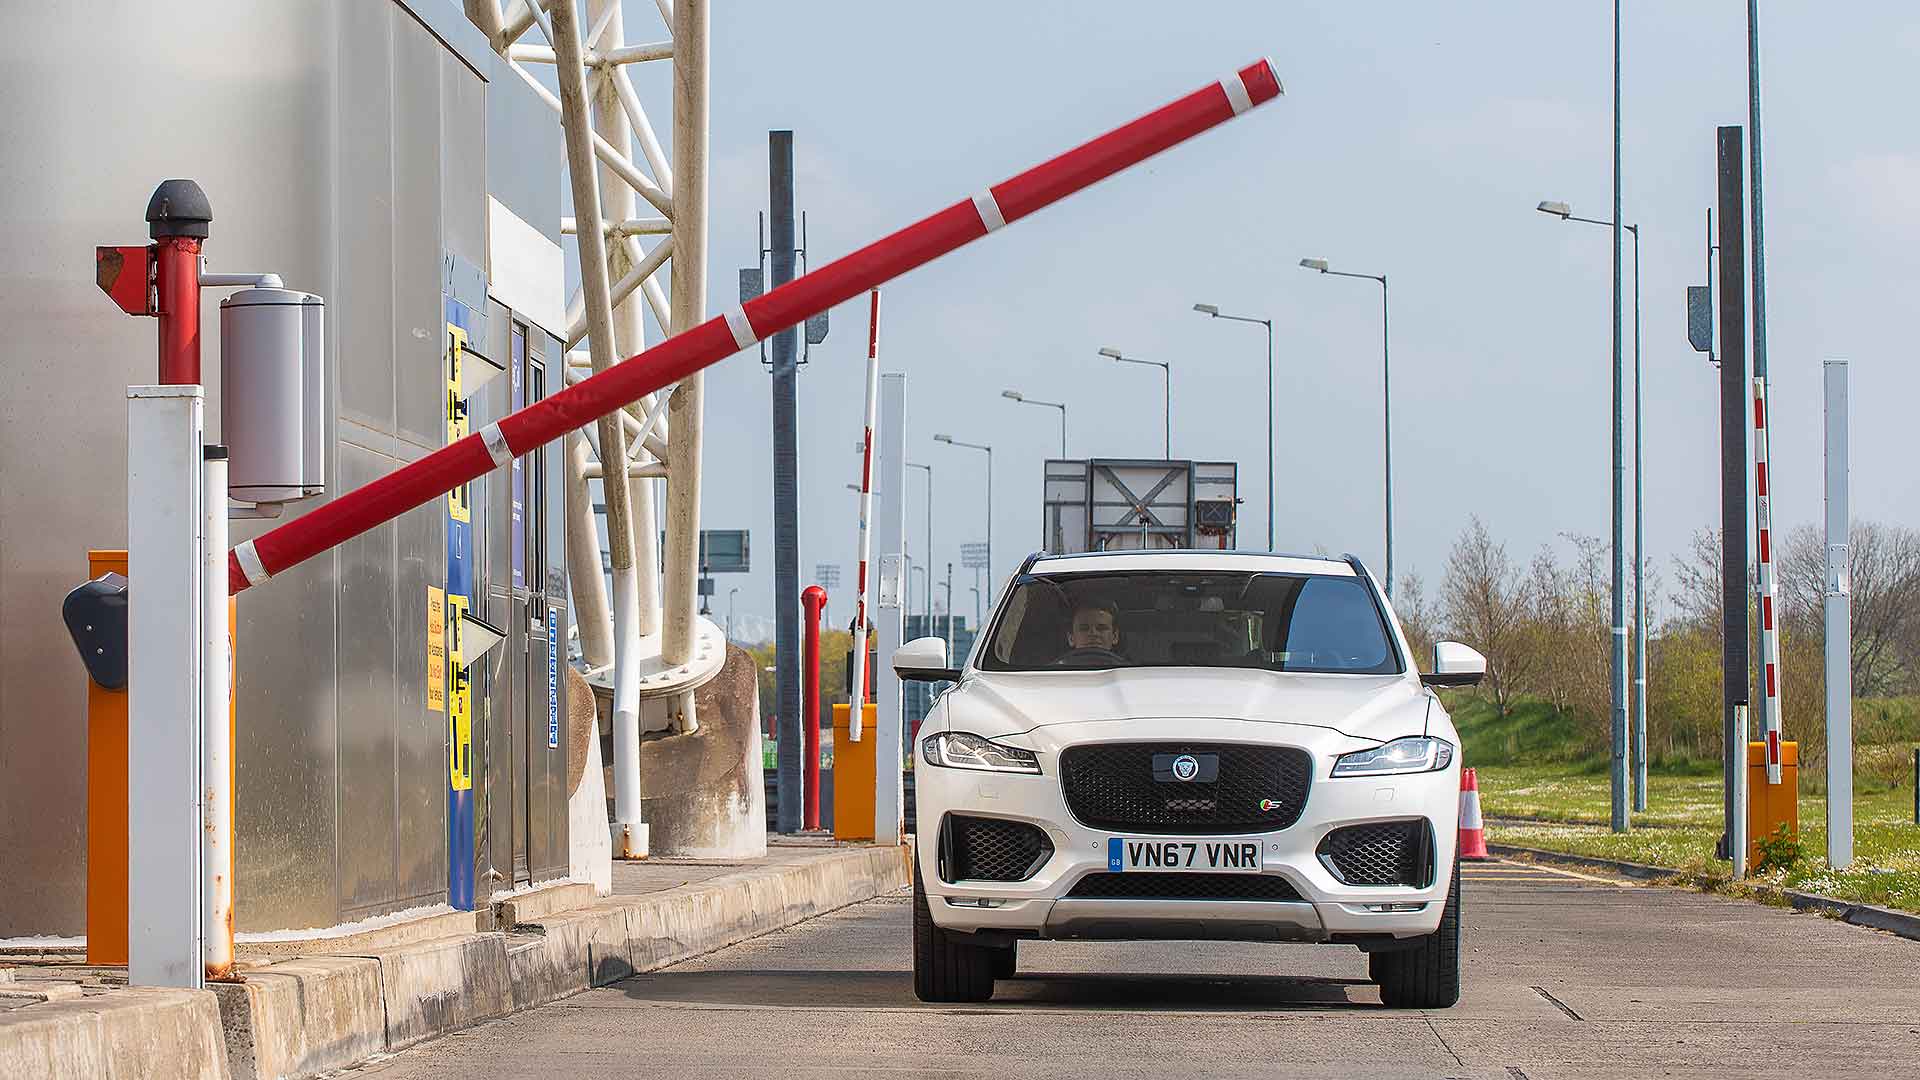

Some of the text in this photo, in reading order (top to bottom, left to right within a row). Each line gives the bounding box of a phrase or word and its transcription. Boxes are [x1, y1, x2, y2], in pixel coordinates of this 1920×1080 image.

[1111, 858, 1121, 866] GB
[1127, 842, 1257, 868] VN67 VNR
